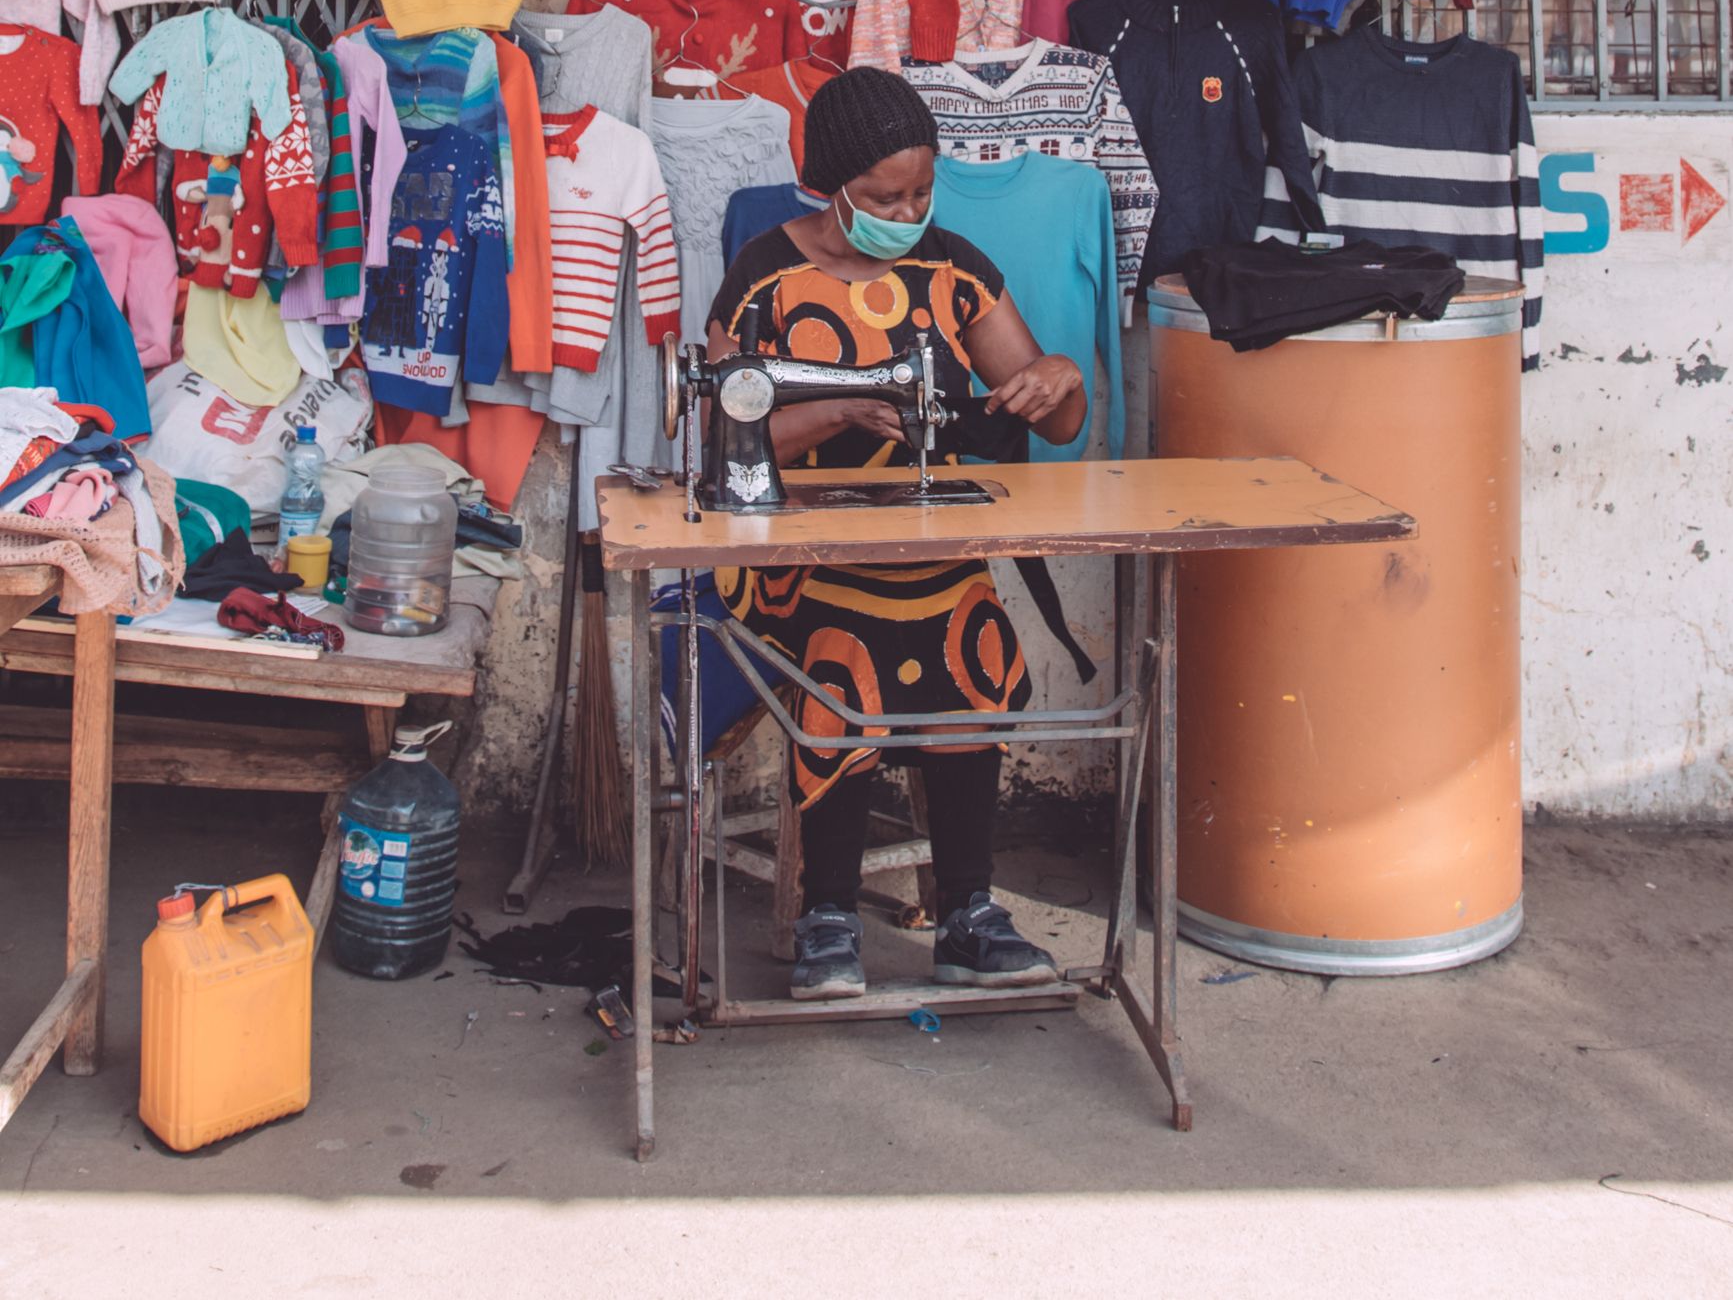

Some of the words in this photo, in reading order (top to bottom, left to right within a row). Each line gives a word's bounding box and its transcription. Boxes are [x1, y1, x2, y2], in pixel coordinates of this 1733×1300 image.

[799, 4, 849, 37] OW
[929, 96, 970, 114] HAPPY
[974, 94, 1049, 114] CHRISTMAS
[417, 350, 432, 364] UP
